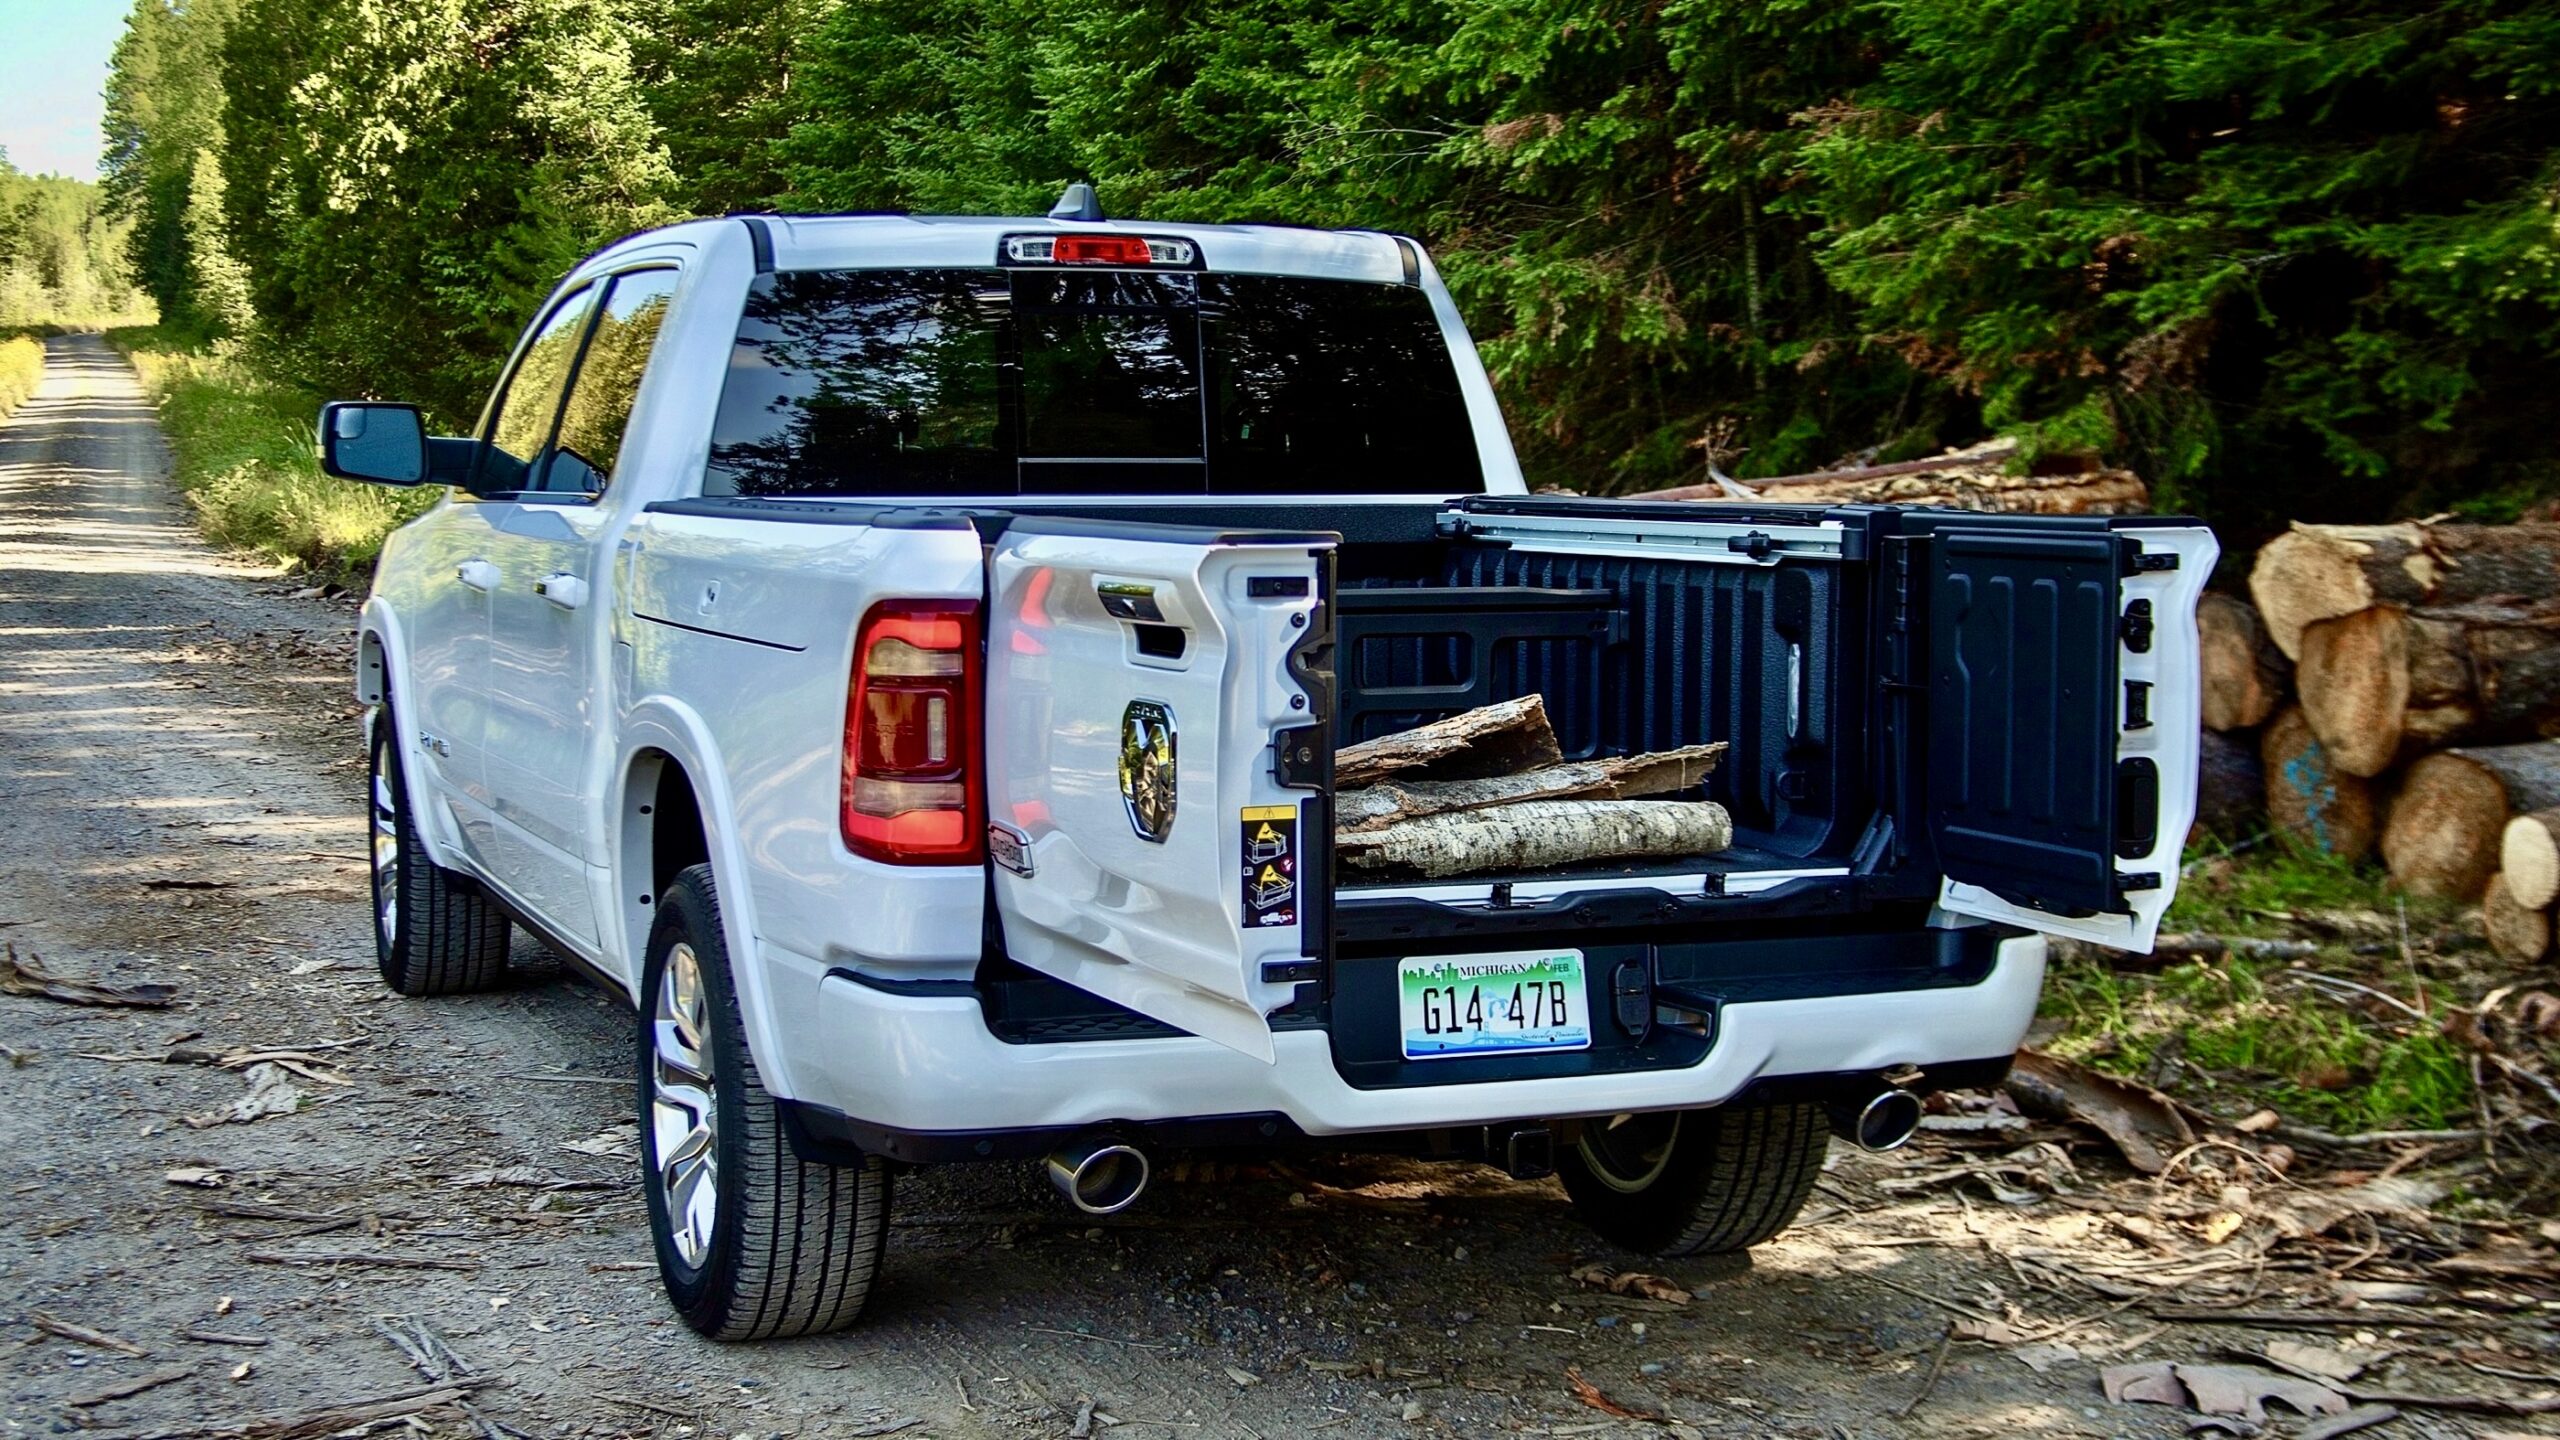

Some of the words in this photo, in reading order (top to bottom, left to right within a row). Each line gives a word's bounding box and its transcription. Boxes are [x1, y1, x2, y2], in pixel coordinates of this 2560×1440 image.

[1460, 962, 1526, 977] MICHIGAN
[1553, 963, 1570, 973] FEB
[1423, 985, 1483, 1034] G14
[1509, 981, 1567, 1029] 47B
